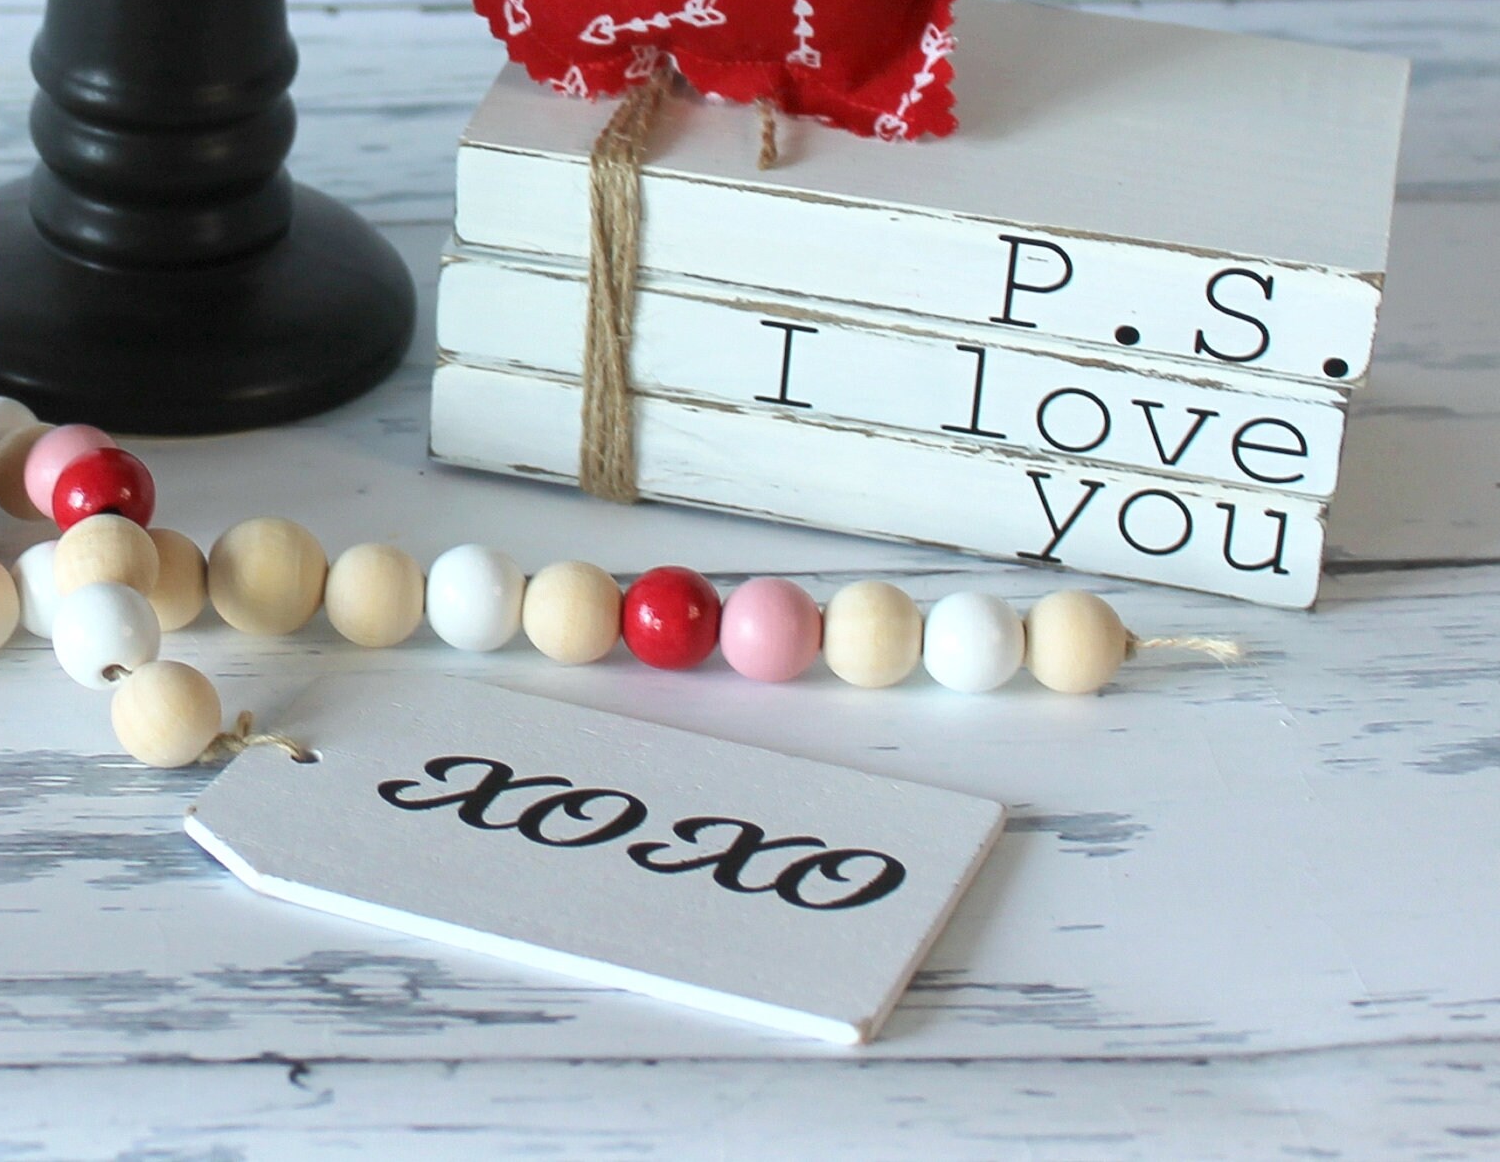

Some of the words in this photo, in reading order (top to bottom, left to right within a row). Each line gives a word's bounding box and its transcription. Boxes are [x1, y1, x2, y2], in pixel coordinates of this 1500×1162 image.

[989, 234, 1349, 379] P.S.
[753, 319, 818, 409] I
[941, 344, 1308, 484] love
[1016, 470, 1289, 575] you
